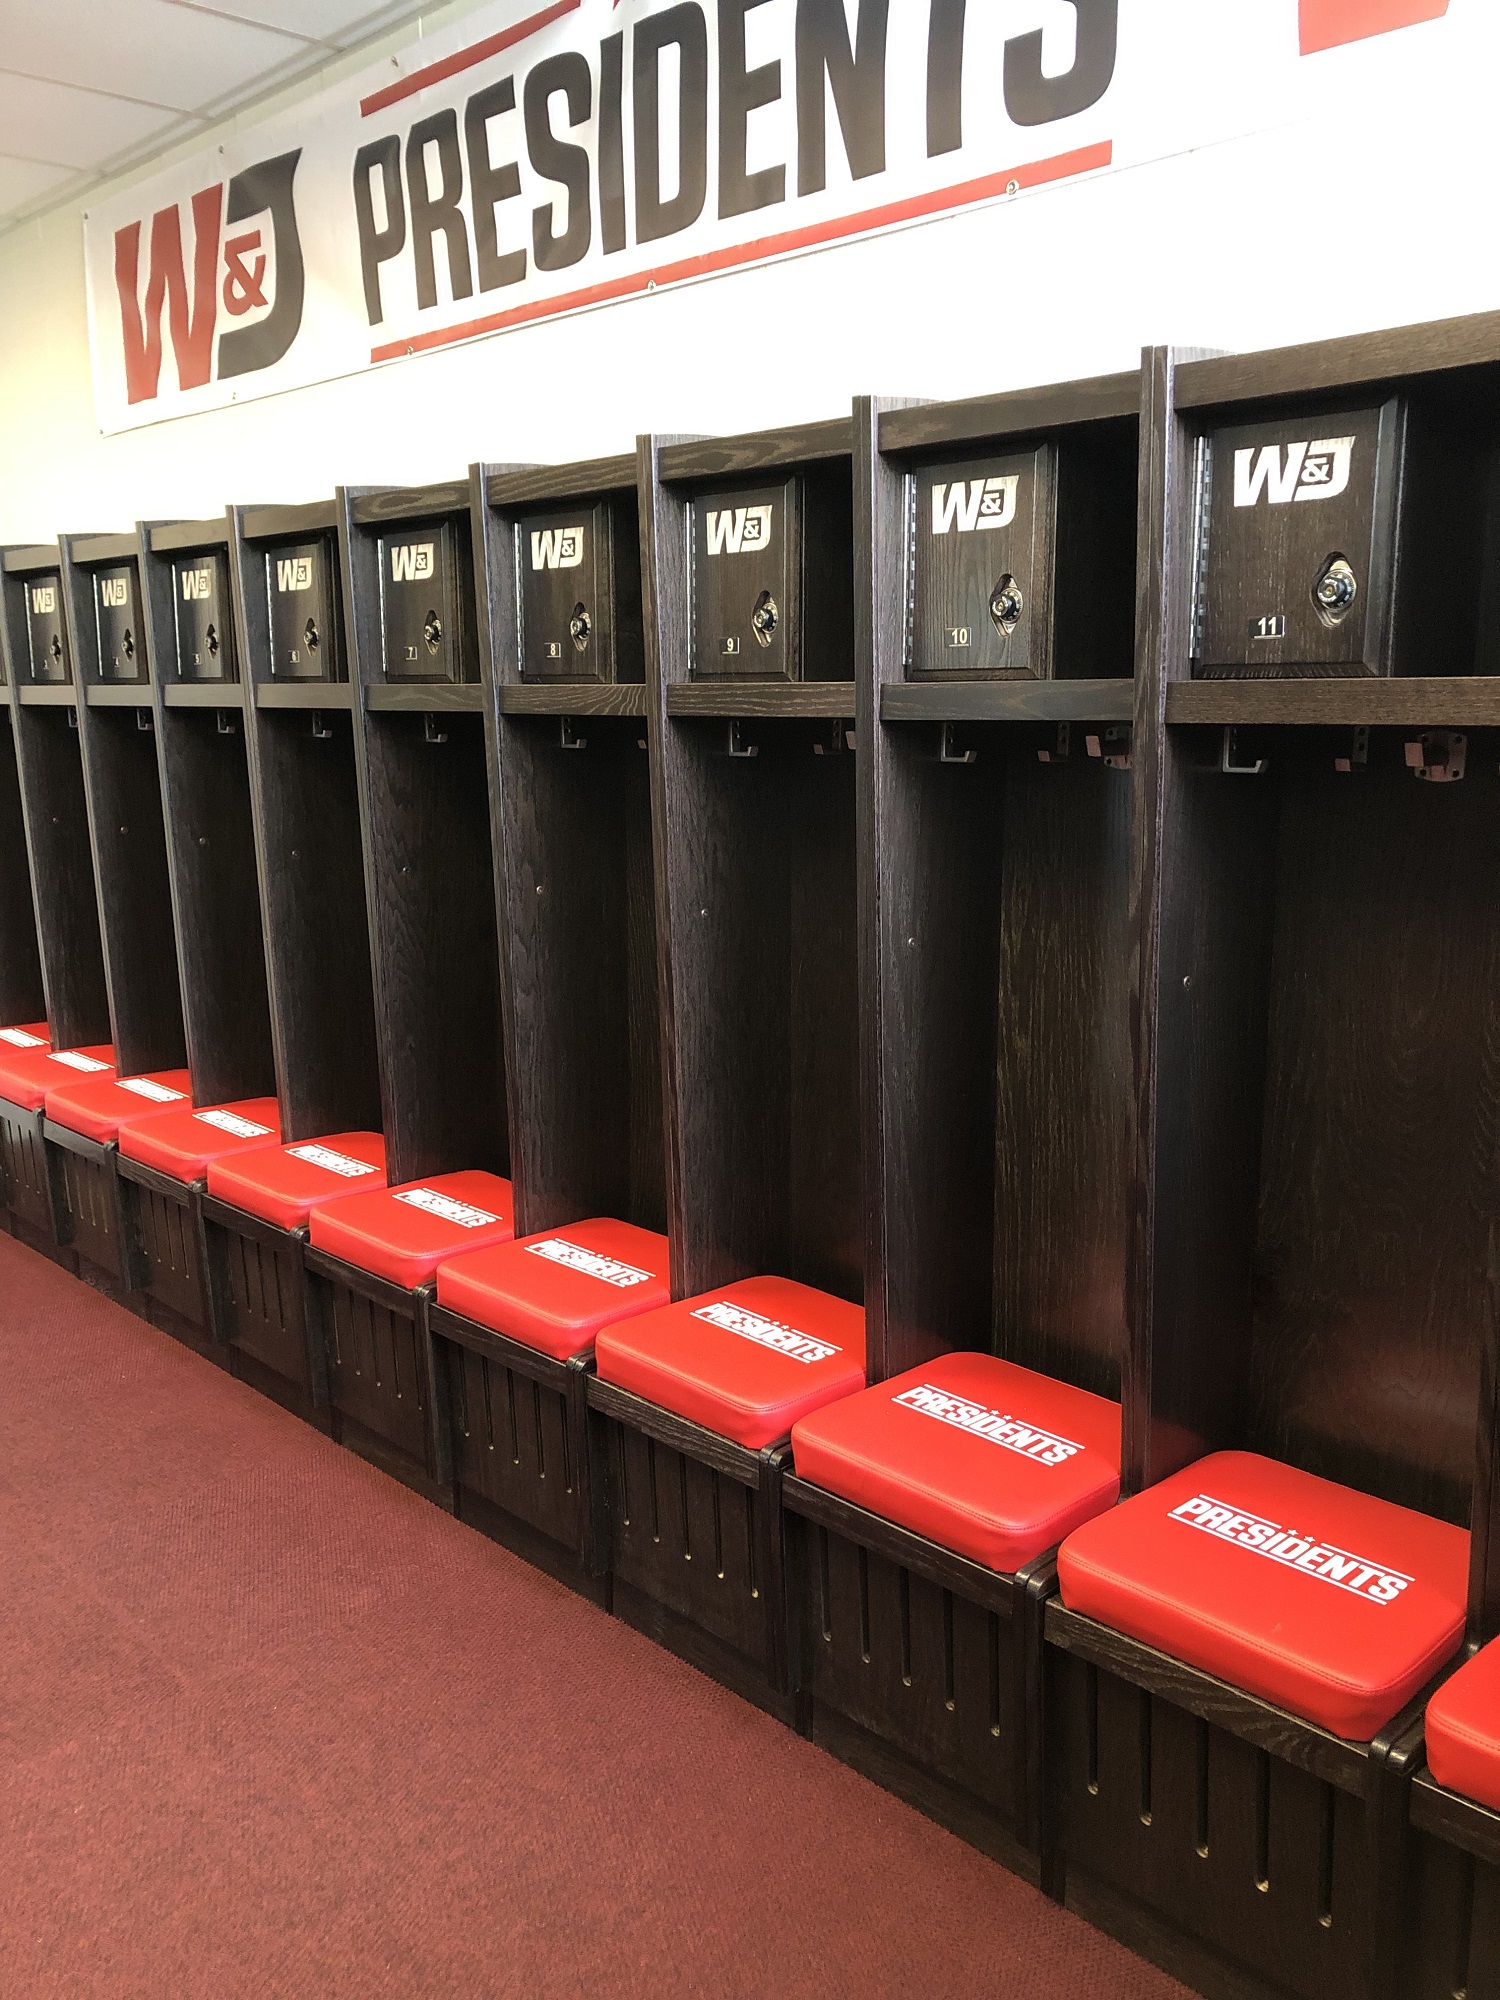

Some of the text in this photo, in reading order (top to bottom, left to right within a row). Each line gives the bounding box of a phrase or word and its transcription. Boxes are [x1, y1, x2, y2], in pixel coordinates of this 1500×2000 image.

[115, 147, 304, 404] W&J
[1233, 436, 1356, 507] W&J
[931, 474, 1020, 535] W&J
[530, 527, 584, 570] W&J
[706, 504, 772, 555] W&J
[277, 557, 312, 591] W&J
[391, 543, 434, 582] W&J
[182, 569, 211, 600] W&J
[726, 637, 735, 652] 9
[951, 628, 968, 645] 10
[1256, 616, 1278, 635] 11
[550, 643, 556, 656] 8
[694, 1303, 835, 1361] PRESIDENTS
[897, 1385, 1078, 1463] PRESIDENTS
[1172, 1497, 1408, 1603] PRESIDENTS
